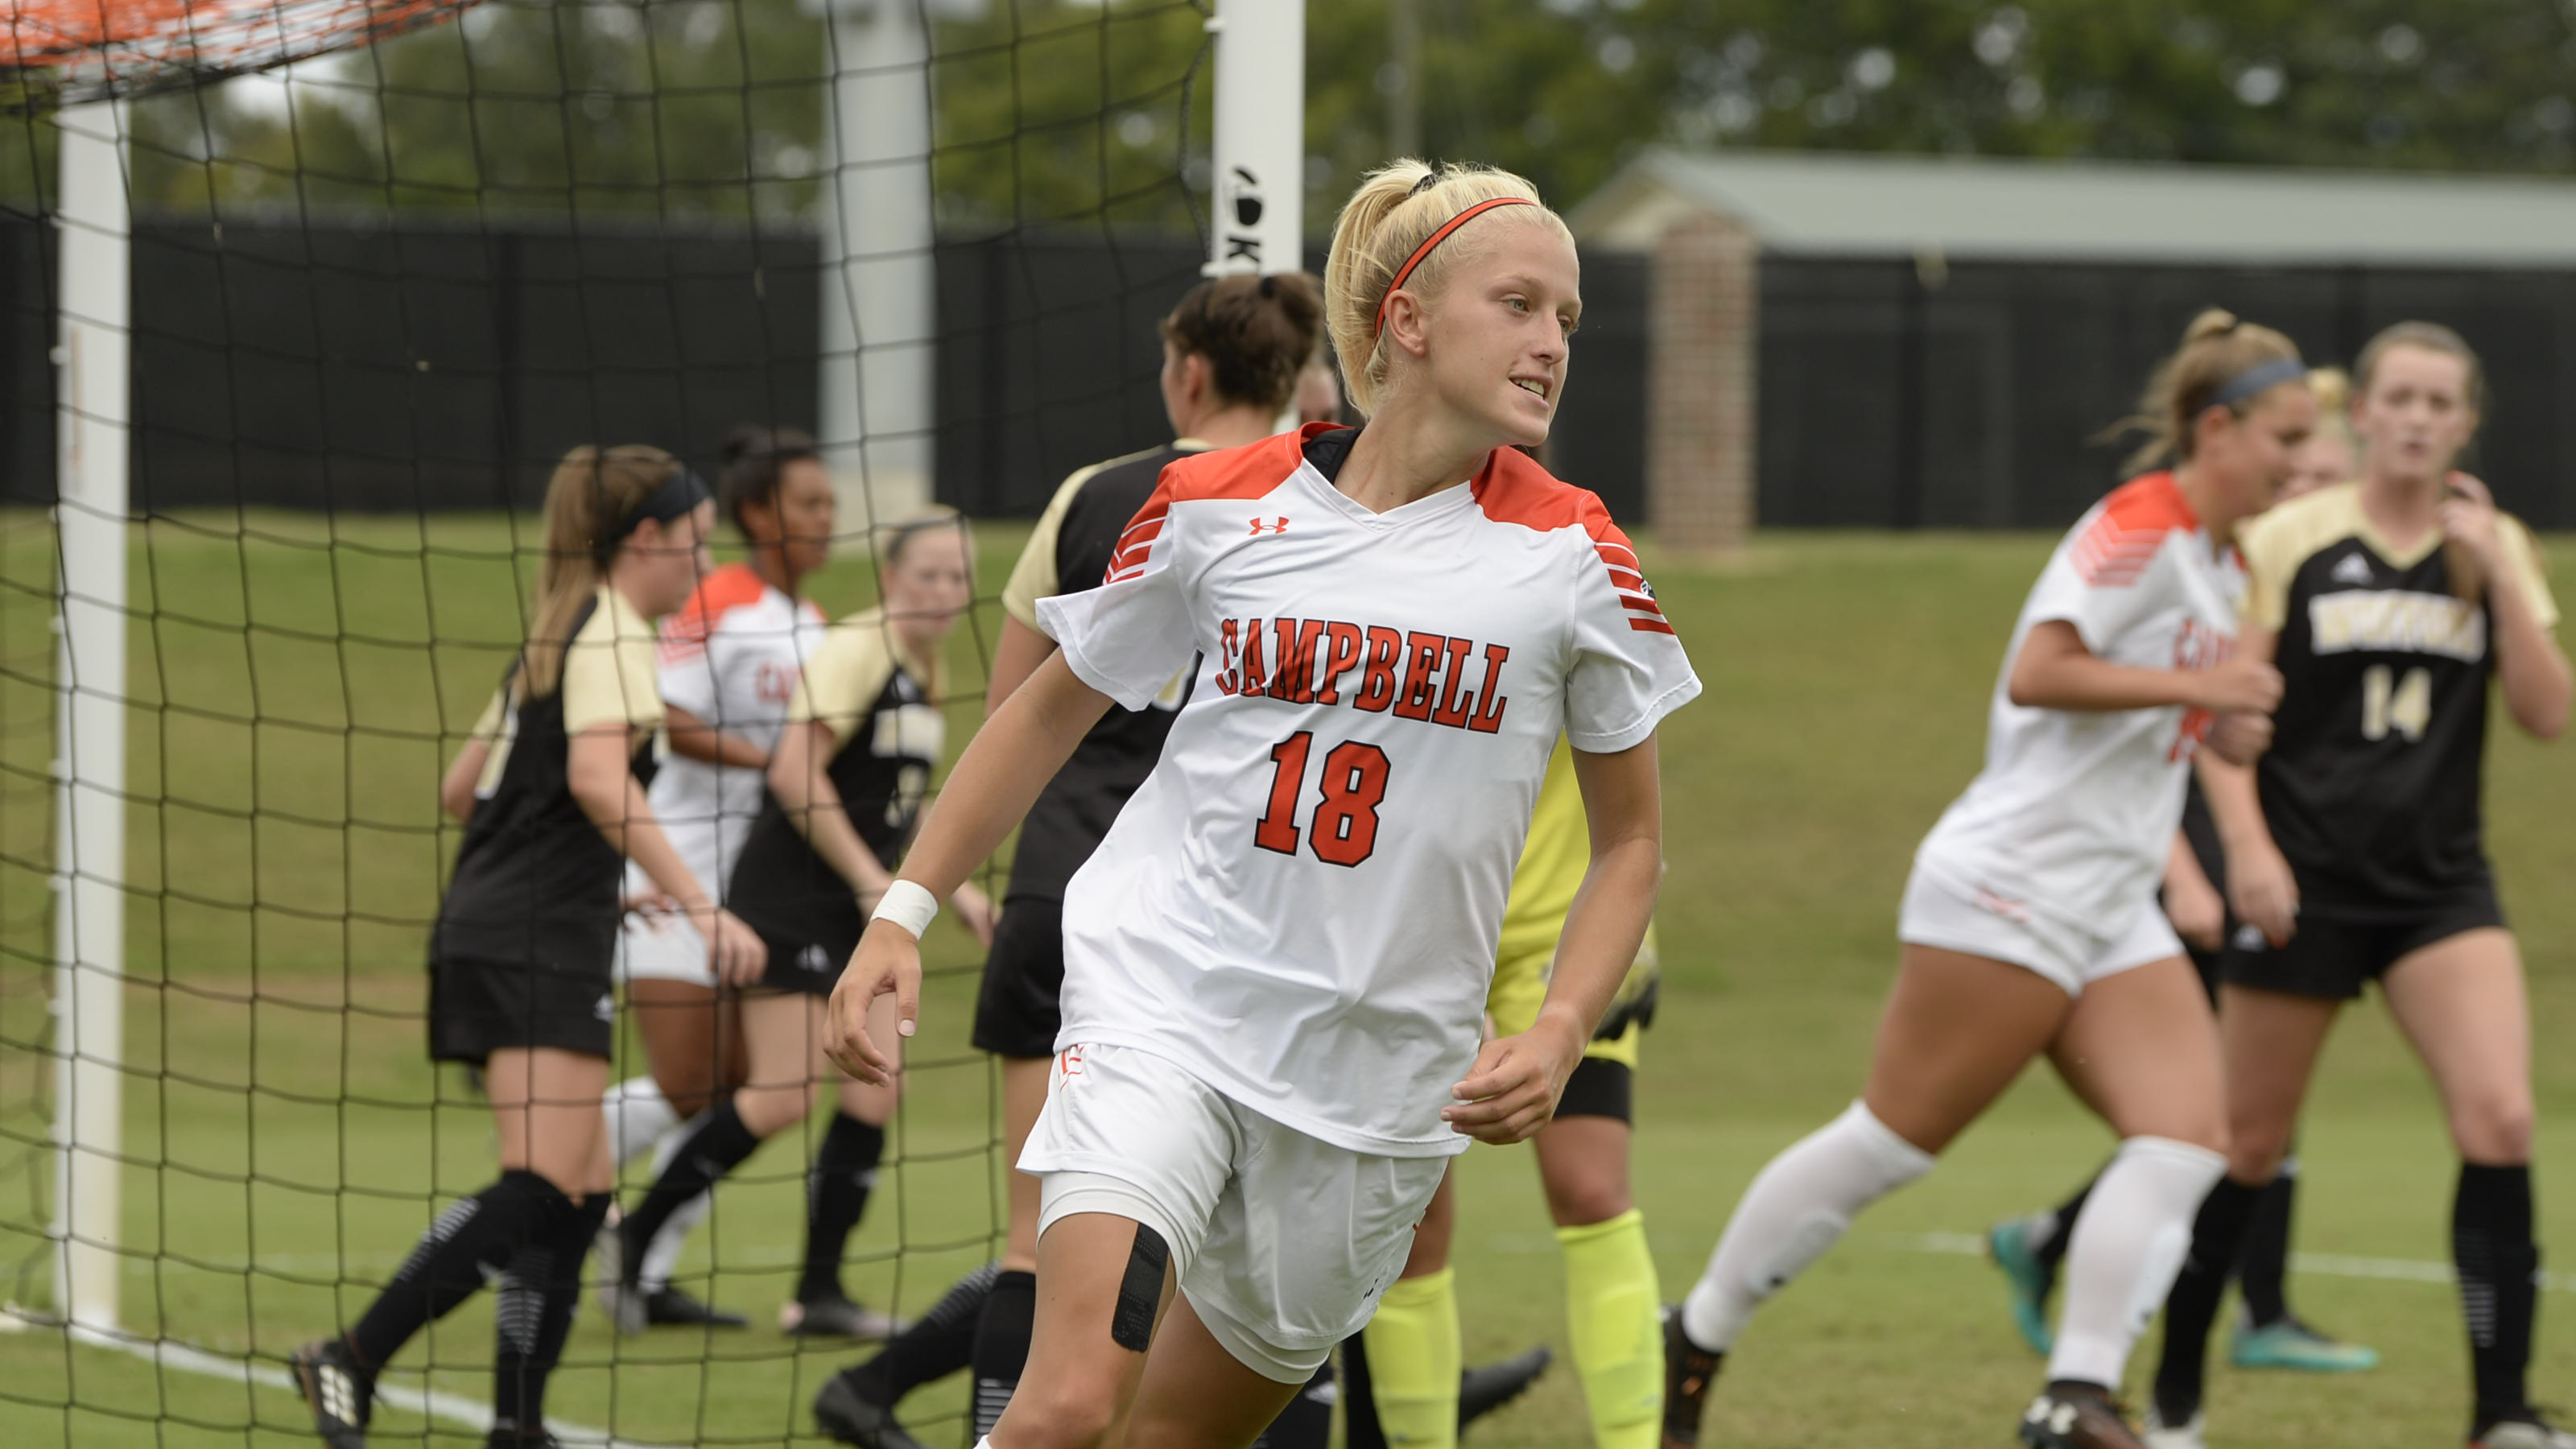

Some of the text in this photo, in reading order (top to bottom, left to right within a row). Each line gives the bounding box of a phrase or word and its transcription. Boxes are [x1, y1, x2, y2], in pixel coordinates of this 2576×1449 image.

[1227, 237, 1261, 263] K
[1216, 617, 1510, 735] CAMPBELL
[2361, 664, 2434, 743] 14
[1253, 730, 1392, 869] 18
